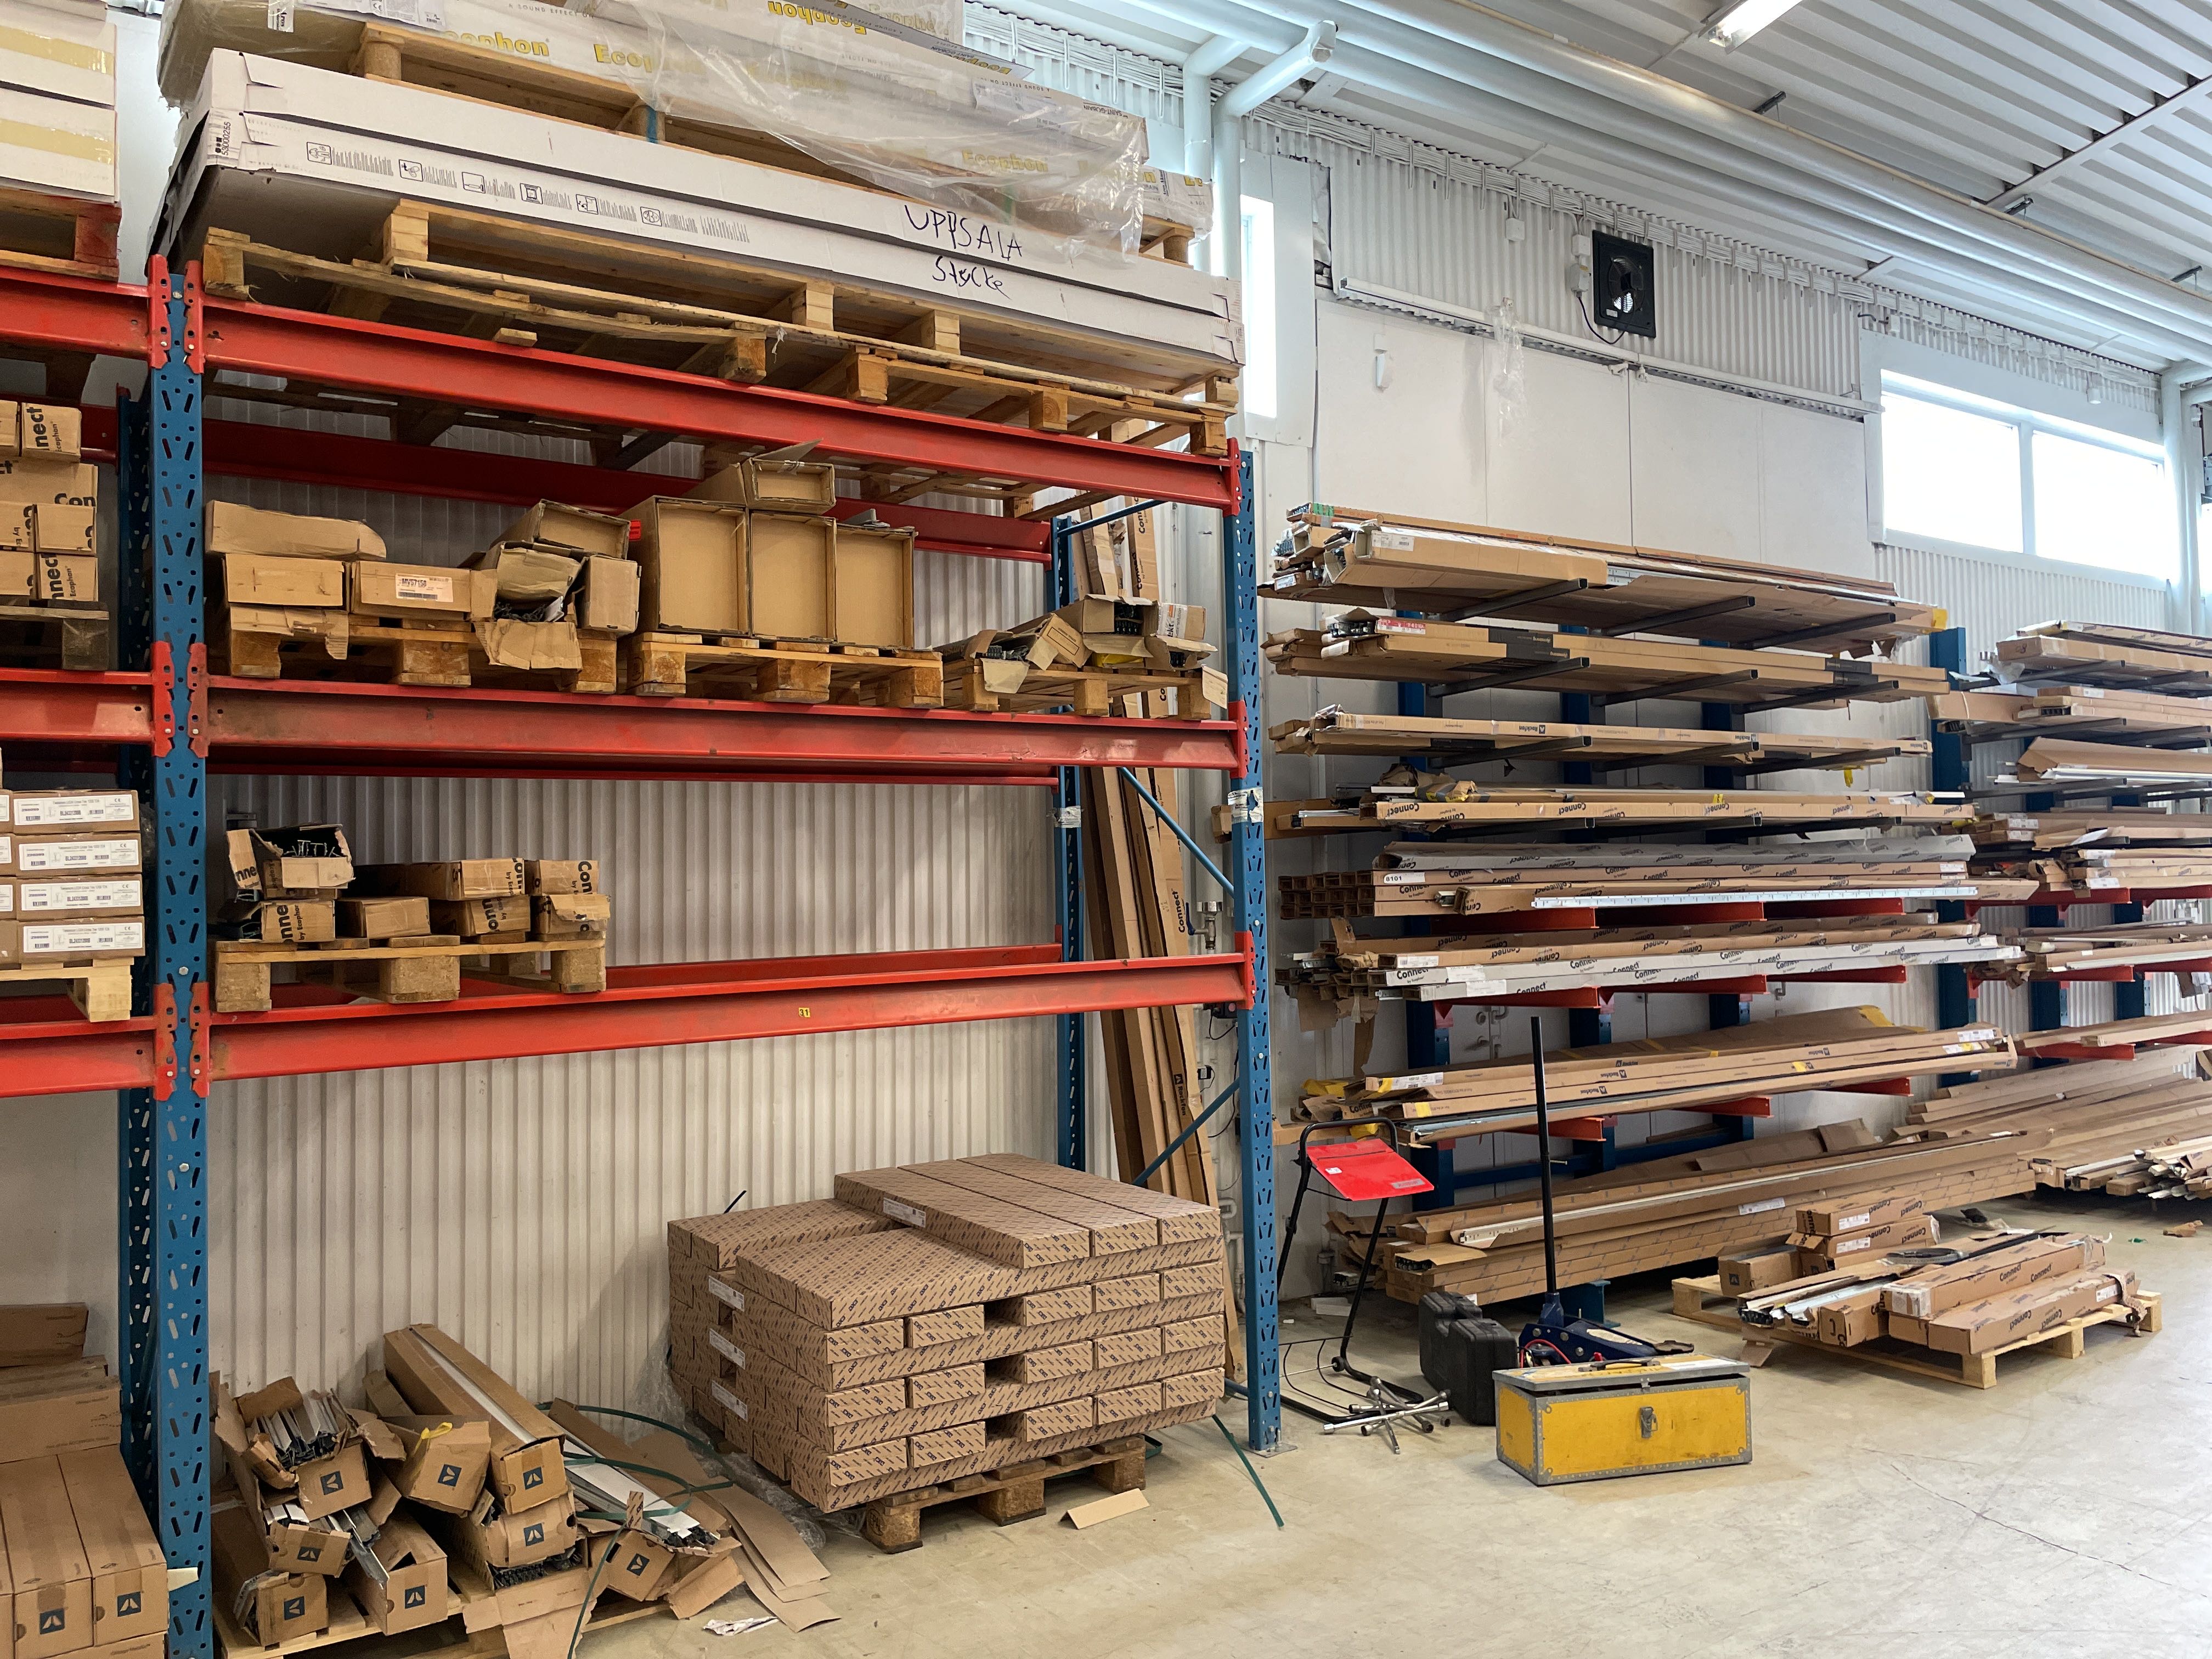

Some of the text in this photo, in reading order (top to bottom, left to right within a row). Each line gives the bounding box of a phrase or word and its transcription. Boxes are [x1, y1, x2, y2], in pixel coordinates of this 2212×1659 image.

[904, 205, 1023, 262] UPPSALA
[1387, 803, 1420, 817] Connect
[1558, 803, 1587, 816] Connect
[1172, 890, 1186, 934] Connect
